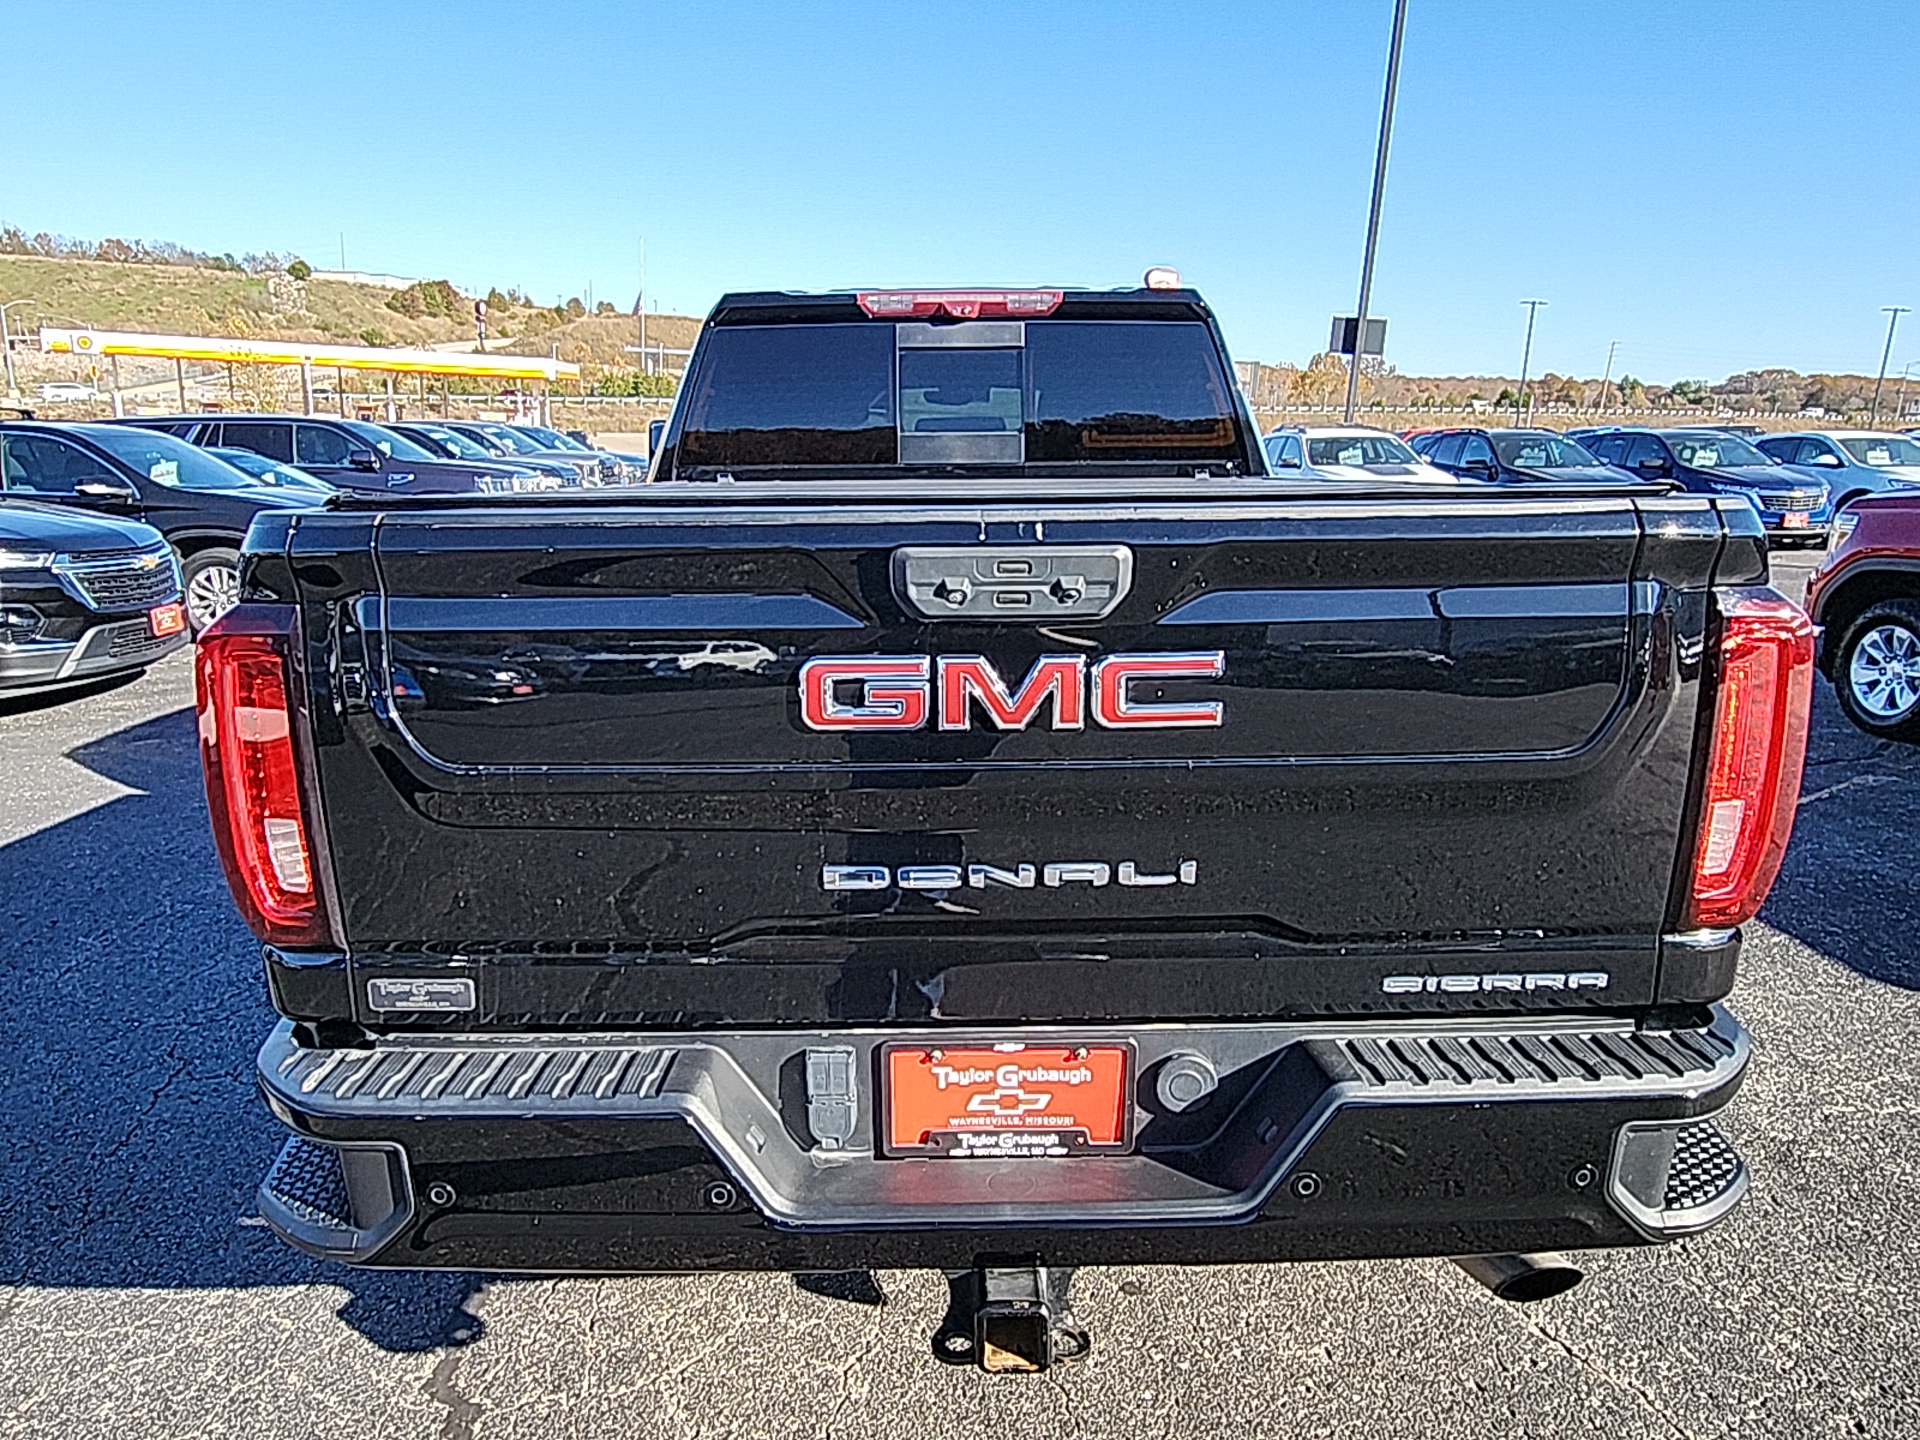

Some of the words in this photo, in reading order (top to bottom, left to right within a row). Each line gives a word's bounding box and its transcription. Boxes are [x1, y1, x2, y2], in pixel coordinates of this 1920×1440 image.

[799, 651, 1226, 732] GMC
[822, 859, 1198, 890] DENALI
[1382, 972, 1610, 994] SIERRA
[931, 1066, 994, 1089] Taylor
[996, 1064, 1092, 1087] Grubaugh
[949, 1116, 1024, 1126] WAYNESVILLE,
[1025, 1116, 1075, 1126] MISSOURI
[957, 1133, 998, 1148] Taylor
[998, 1132, 1060, 1148] Grubaugh
